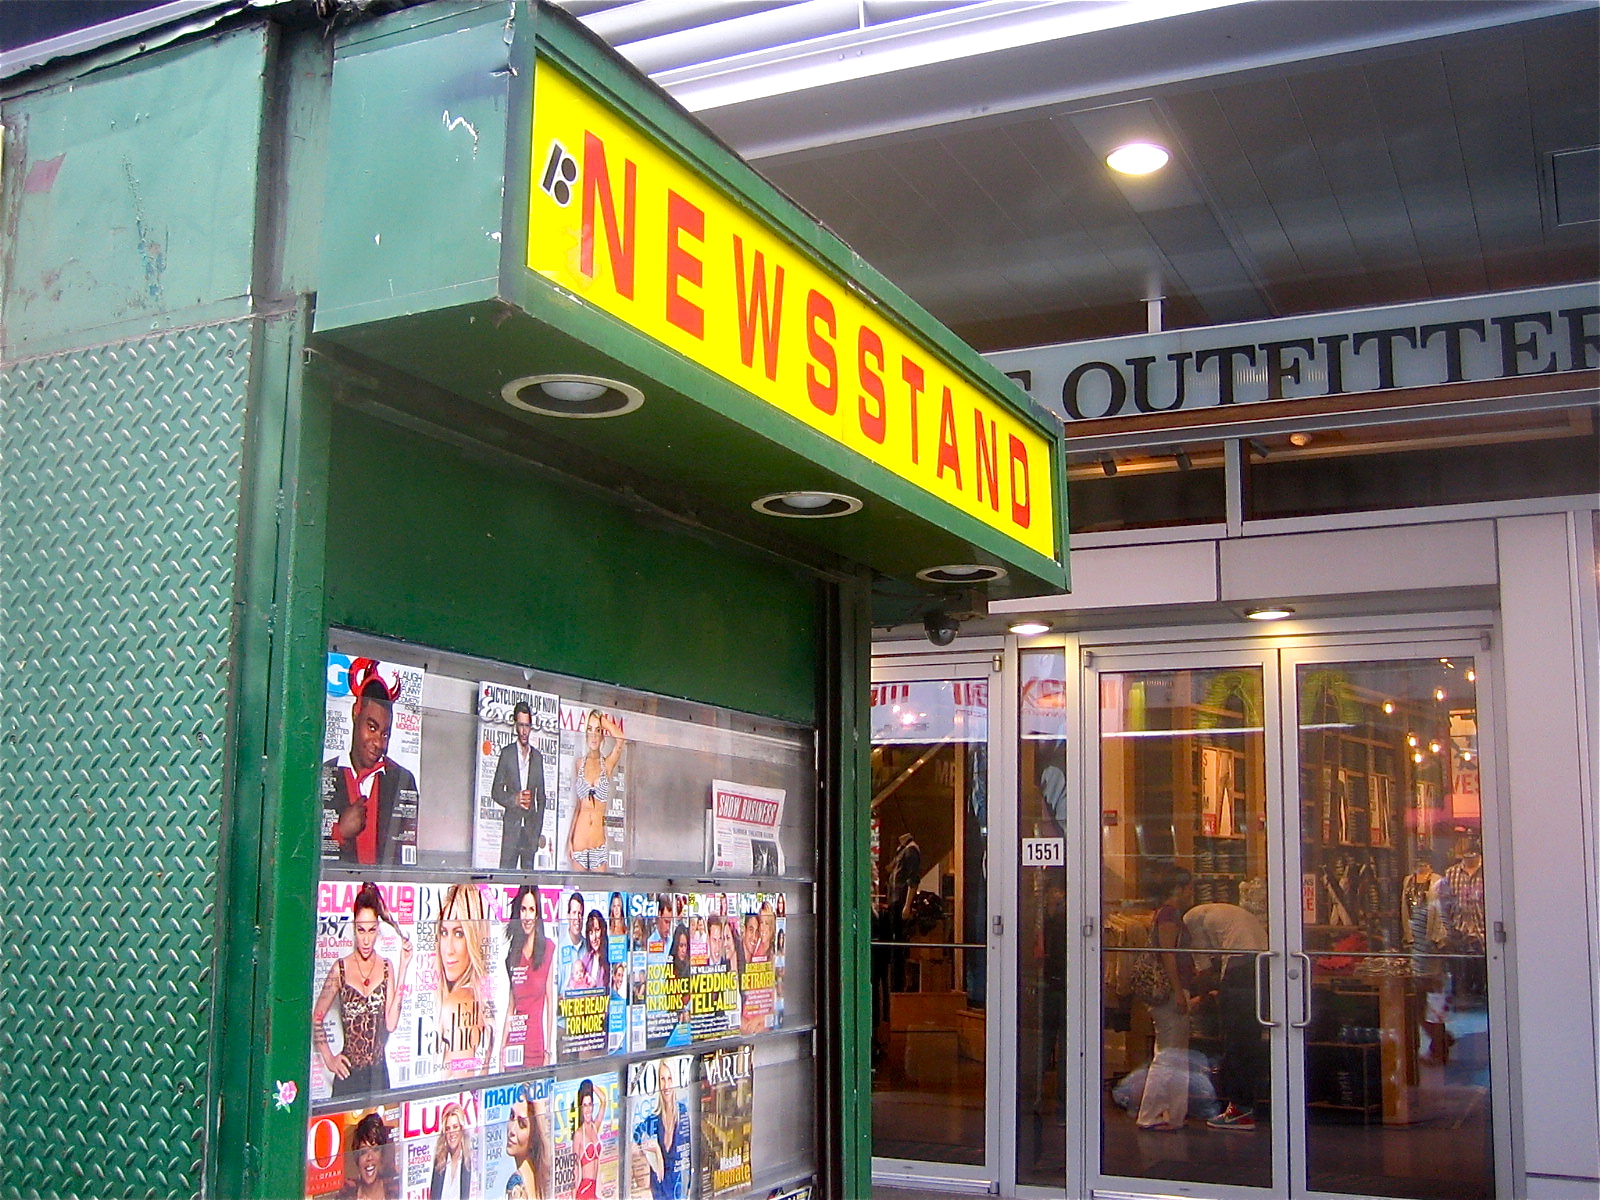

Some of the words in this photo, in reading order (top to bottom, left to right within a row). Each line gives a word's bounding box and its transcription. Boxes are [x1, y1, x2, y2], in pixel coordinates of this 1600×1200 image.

[580, 129, 1030, 529] NEWSSTAND
[396, 712, 421, 725] TRACY
[480, 697, 559, 736] Esqire
[559, 707, 625, 736] MAIM
[718, 794, 742, 819] SHOW
[741, 798, 777, 824] BUSINESS
[1027, 843, 1060, 860] 1551
[416, 921, 438, 935] BEST
[328, 936, 353, 948] Outfits
[416, 943, 437, 952] SHOES
[320, 948, 339, 959] Ideas
[415, 970, 441, 985] NEW
[647, 963, 675, 979] ROYAL
[415, 982, 438, 992] LOOKS
[646, 977, 689, 996] ROMANCE
[690, 971, 737, 993] WEDDING
[585, 995, 610, 1015] READY
[646, 996, 657, 1012] IN
[659, 992, 684, 1011] RUINS
[457, 1001, 479, 1028] Fall
[417, 1013, 495, 1056] Fashion
[566, 1016, 581, 1035] FOR
[629, 1058, 690, 1096] VOE
[484, 1083, 525, 1108] marie
[308, 1119, 340, 1169] O
[486, 1129, 502, 1142] SKIN
[486, 1147, 502, 1160] HAIR
[555, 1153, 578, 1171] POWER
[555, 1168, 576, 1186] FOODS
